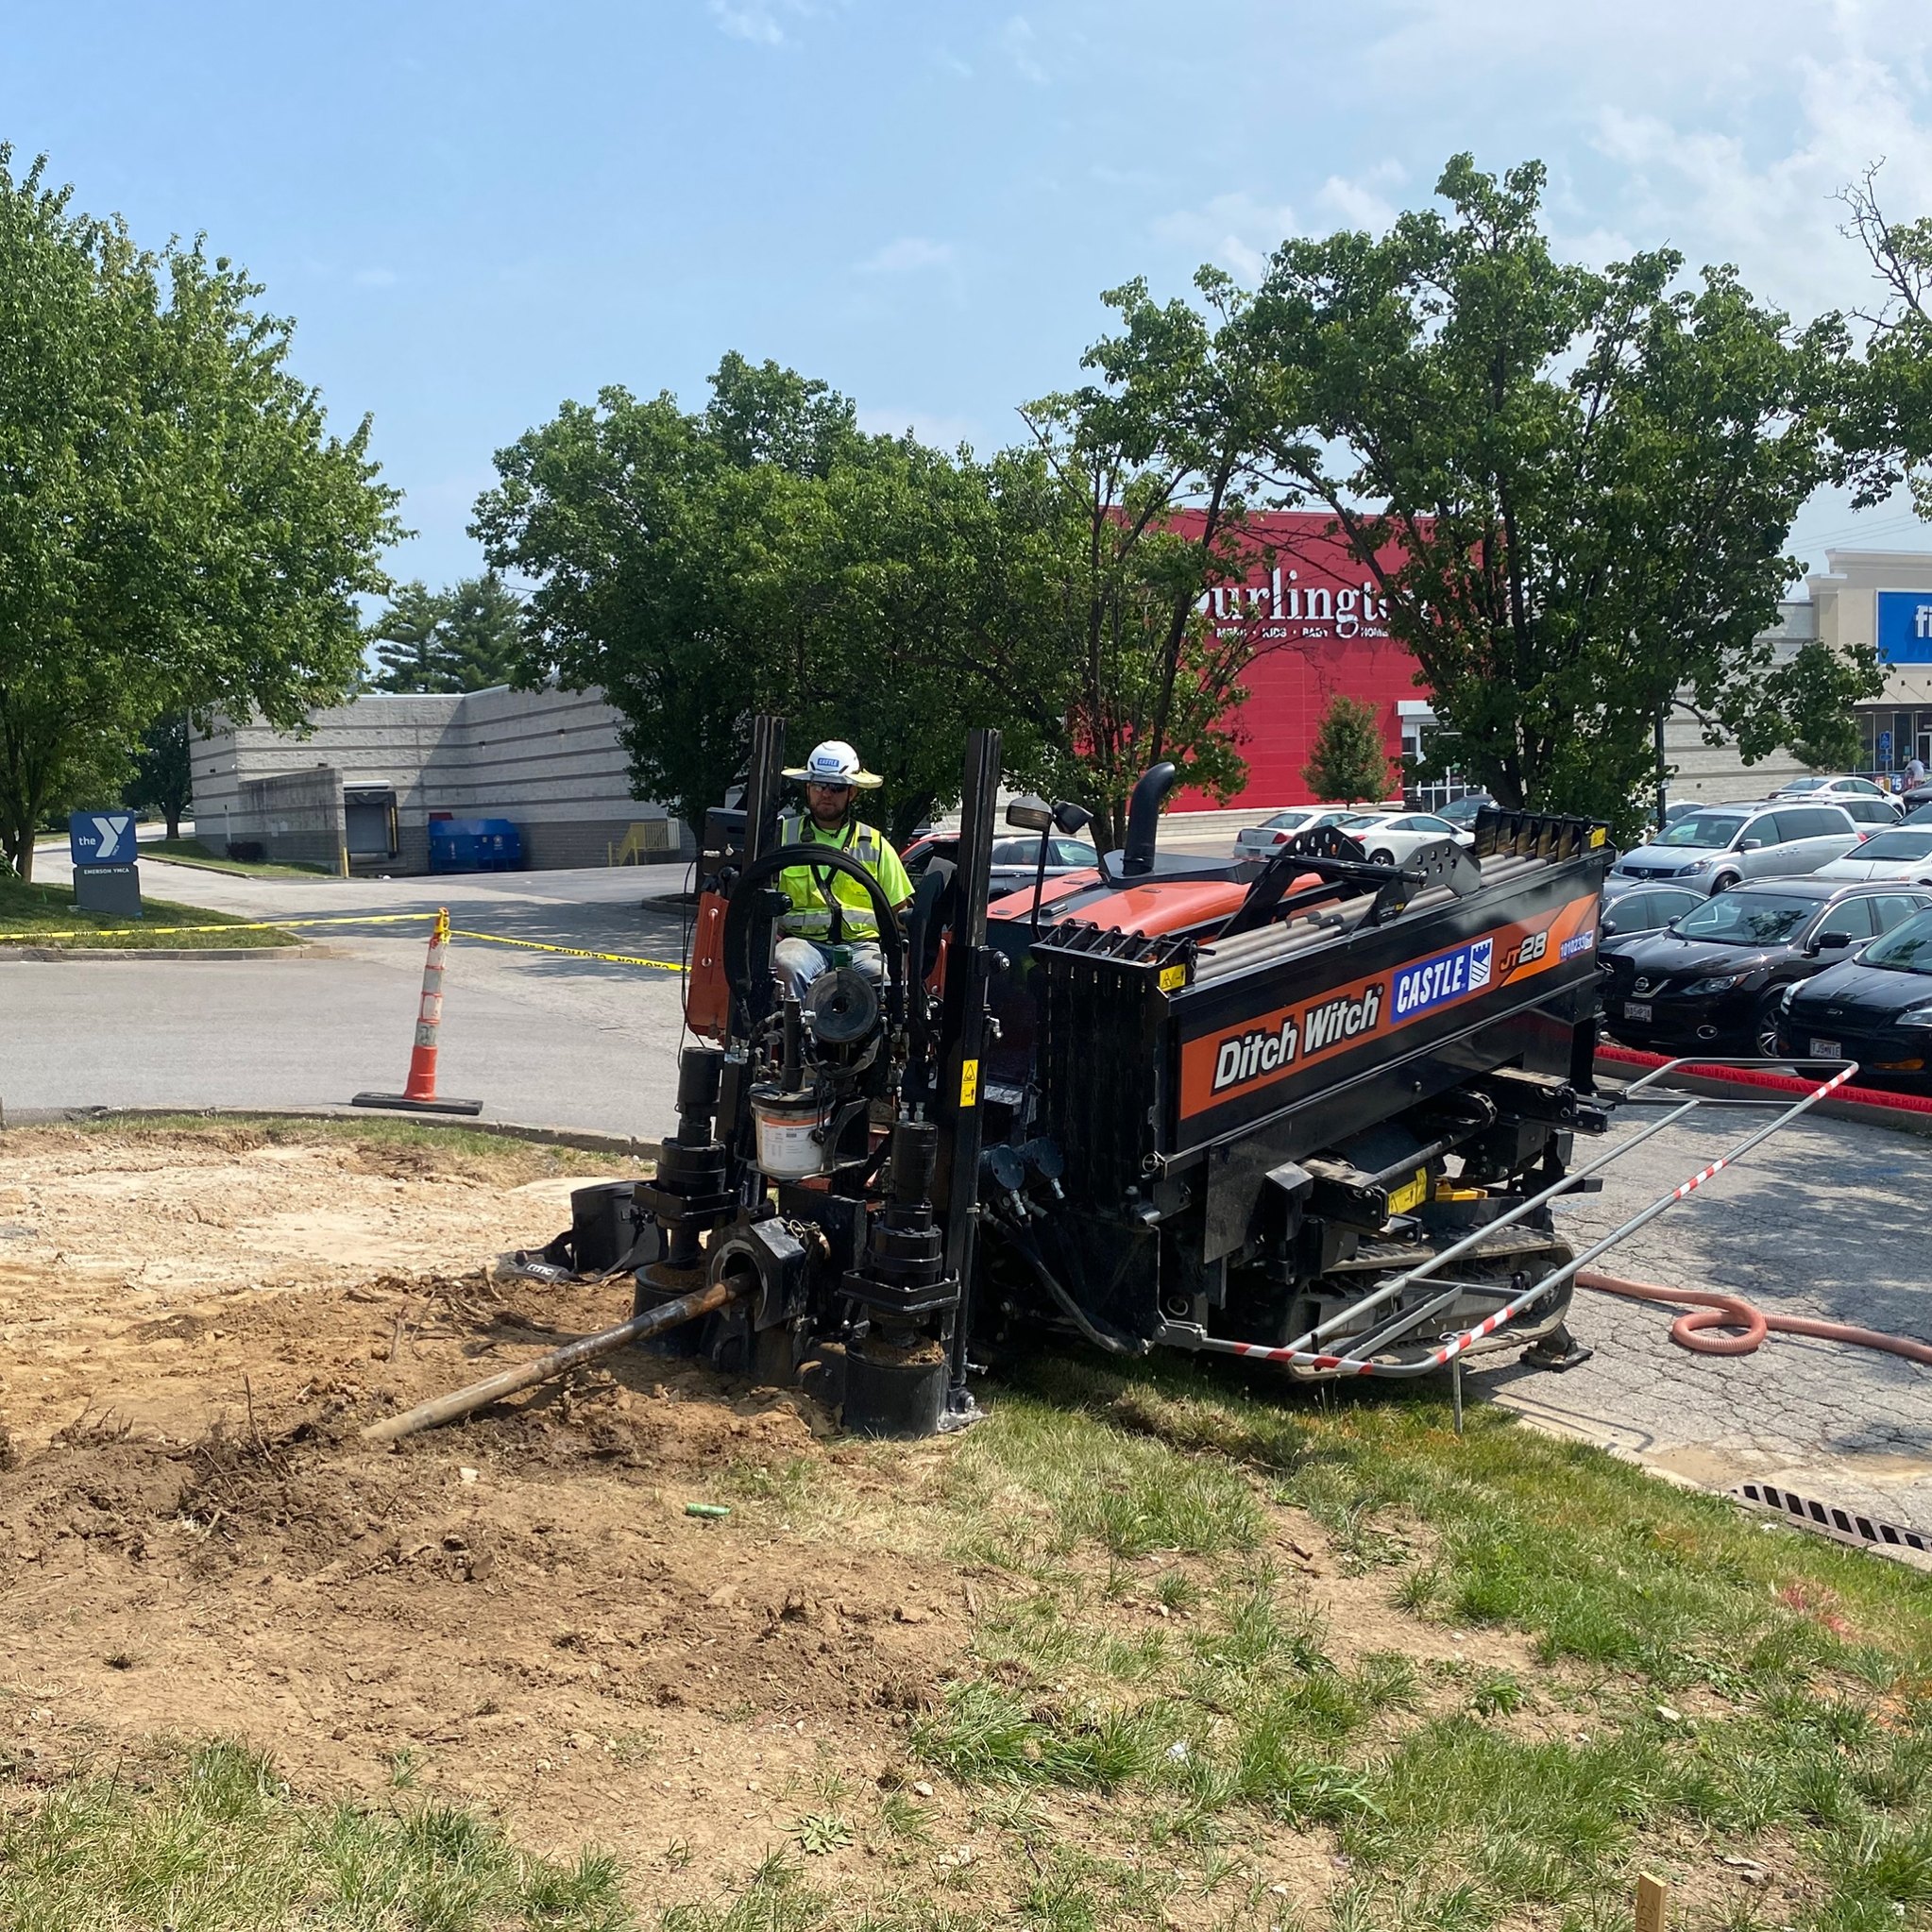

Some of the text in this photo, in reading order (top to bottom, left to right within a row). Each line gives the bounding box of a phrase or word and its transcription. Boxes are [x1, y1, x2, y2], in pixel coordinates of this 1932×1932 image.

[78, 836, 96, 846] the
[1500, 931, 1548, 971] JT28
[1397, 955, 1465, 1013] CASTLE
[1214, 989, 1380, 1090] Ditch Witch
